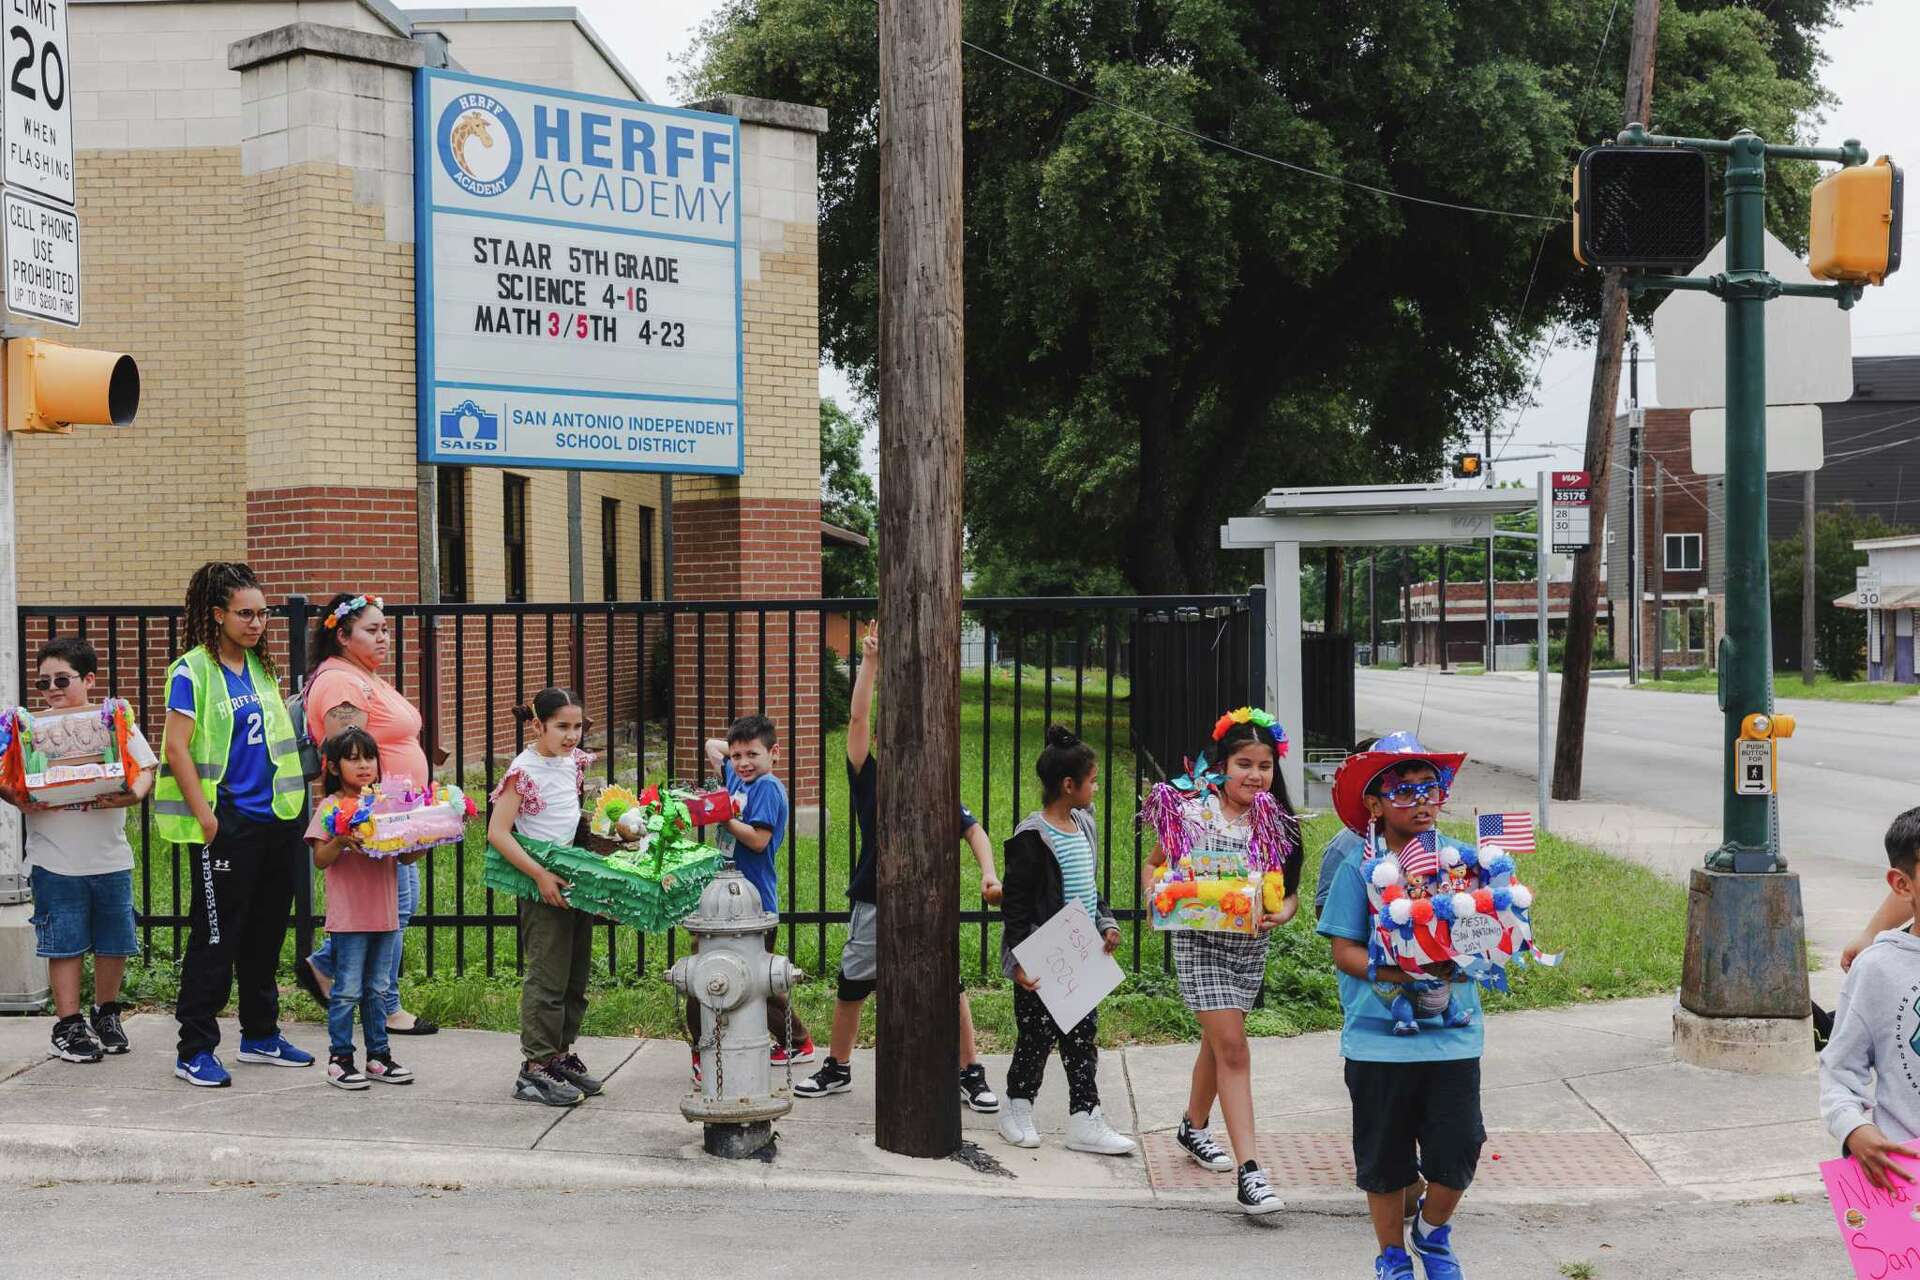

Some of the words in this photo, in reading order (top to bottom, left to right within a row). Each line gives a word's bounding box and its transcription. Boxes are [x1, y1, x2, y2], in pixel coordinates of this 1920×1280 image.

[14, 0, 57, 31] LIMIT
[10, 25, 64, 111] 20
[459, 94, 503, 115] HERFF
[23, 116, 57, 146] WHEN
[534, 105, 731, 183] HERFF
[10, 142, 70, 181] FLASHING
[453, 170, 509, 195] ACADEMY
[529, 165, 731, 225] ACADEMY
[10, 204, 36, 232] CELL
[41, 213, 74, 243] PHONE
[33, 237, 54, 264] USE
[473, 236, 552, 271] STAAR
[568, 246, 609, 277] 5TH
[614, 251, 679, 284] GRADE
[13, 259, 74, 295] PROHIBITED
[14, 286, 24, 303] UP
[28, 289, 37, 306] TO
[60, 298, 74, 316] FINE
[497, 272, 587, 307] SCIENCE
[601, 283, 648, 314] 4-16
[474, 304, 541, 336] MATH
[547, 311, 617, 343] 3/5TH
[638, 319, 685, 348] 4-23
[512, 409, 547, 426] SAN
[552, 411, 624, 431] ANTONIO
[628, 416, 735, 436] INDEPENDENT
[440, 440, 498, 451] SAISD
[556, 433, 622, 451] SCHOOL
[627, 438, 697, 454] DISTRICT
[1556, 492, 1586, 501] 35176
[1555, 522, 1568, 530] 30
[1556, 510, 1568, 518] 28
[1860, 593, 1879, 605] 30
[216, 695, 250, 720] HRFF
[1460, 916, 1489, 927] FIESTA
